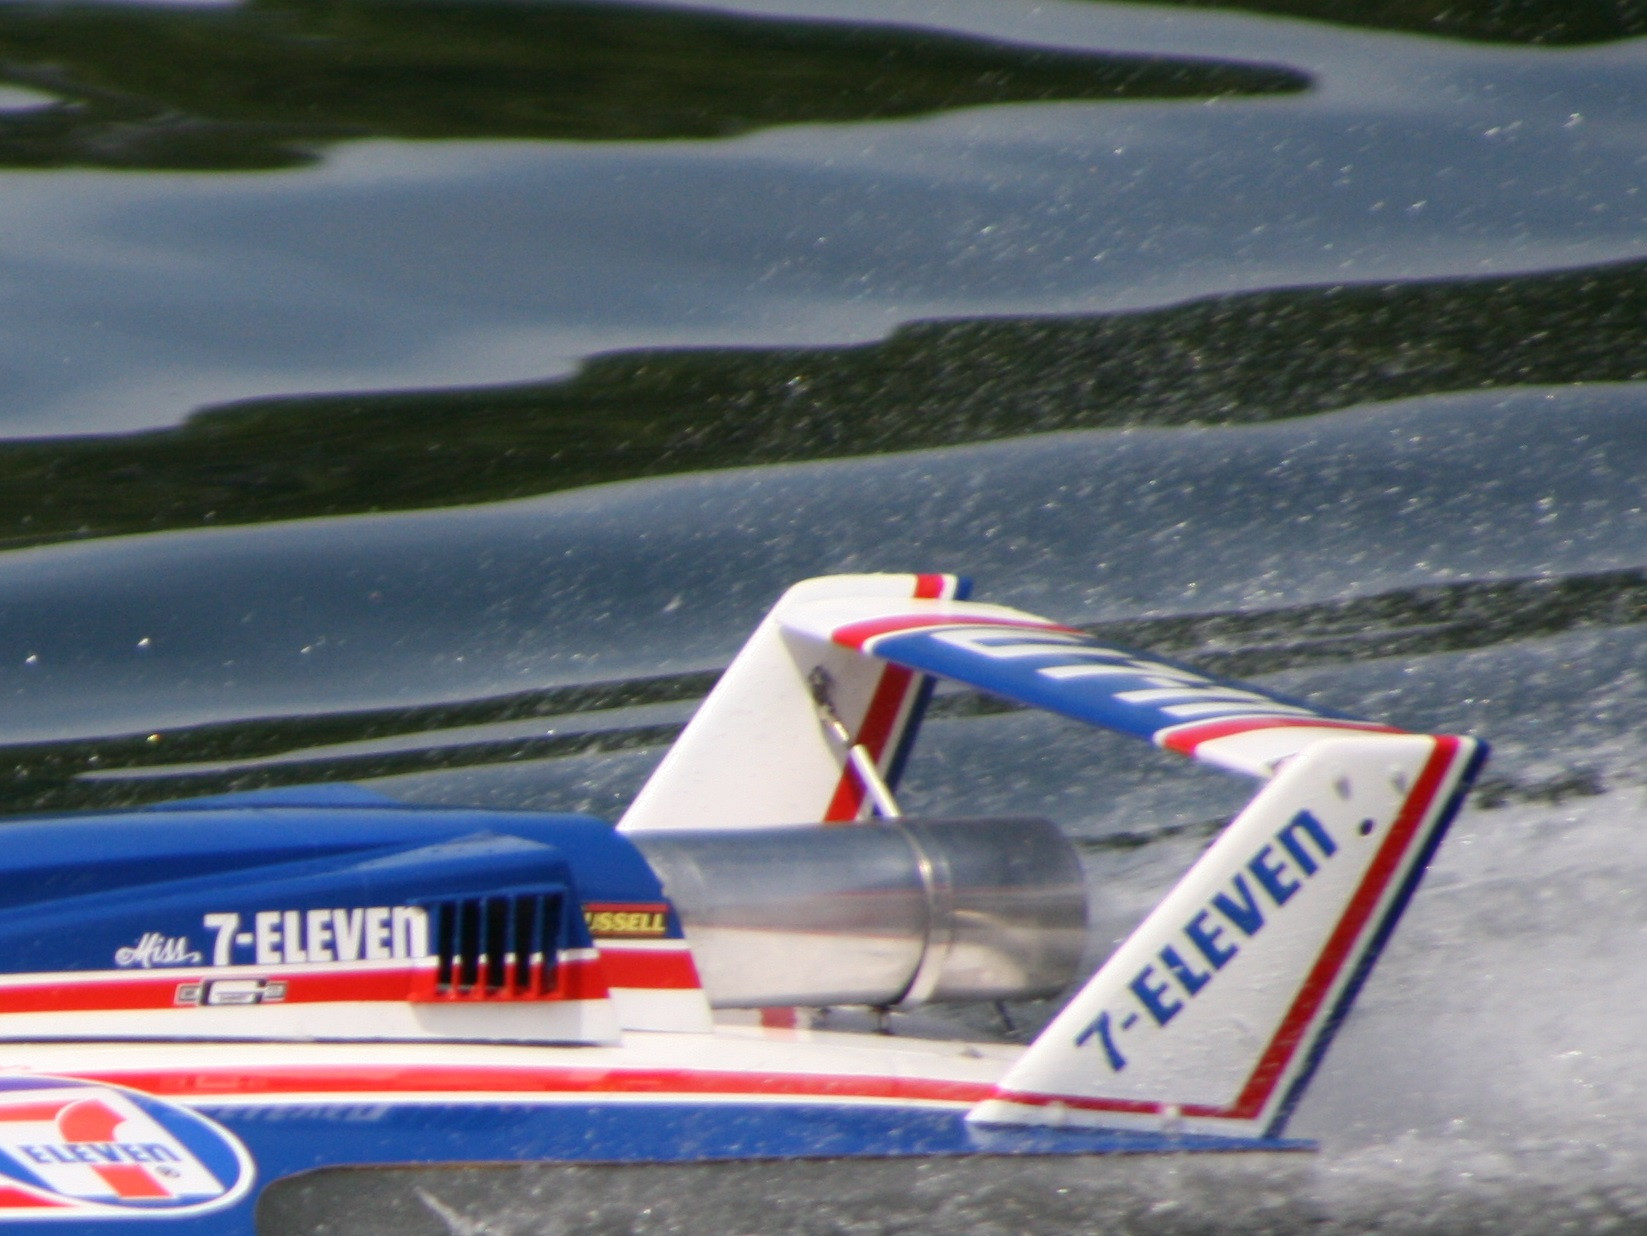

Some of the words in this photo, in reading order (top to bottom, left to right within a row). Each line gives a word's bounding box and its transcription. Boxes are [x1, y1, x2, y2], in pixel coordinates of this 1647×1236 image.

[114, 932, 202, 968] Miss
[204, 905, 430, 967] 7-ELEVEN
[17, 1142, 183, 1165] ELEVEN
